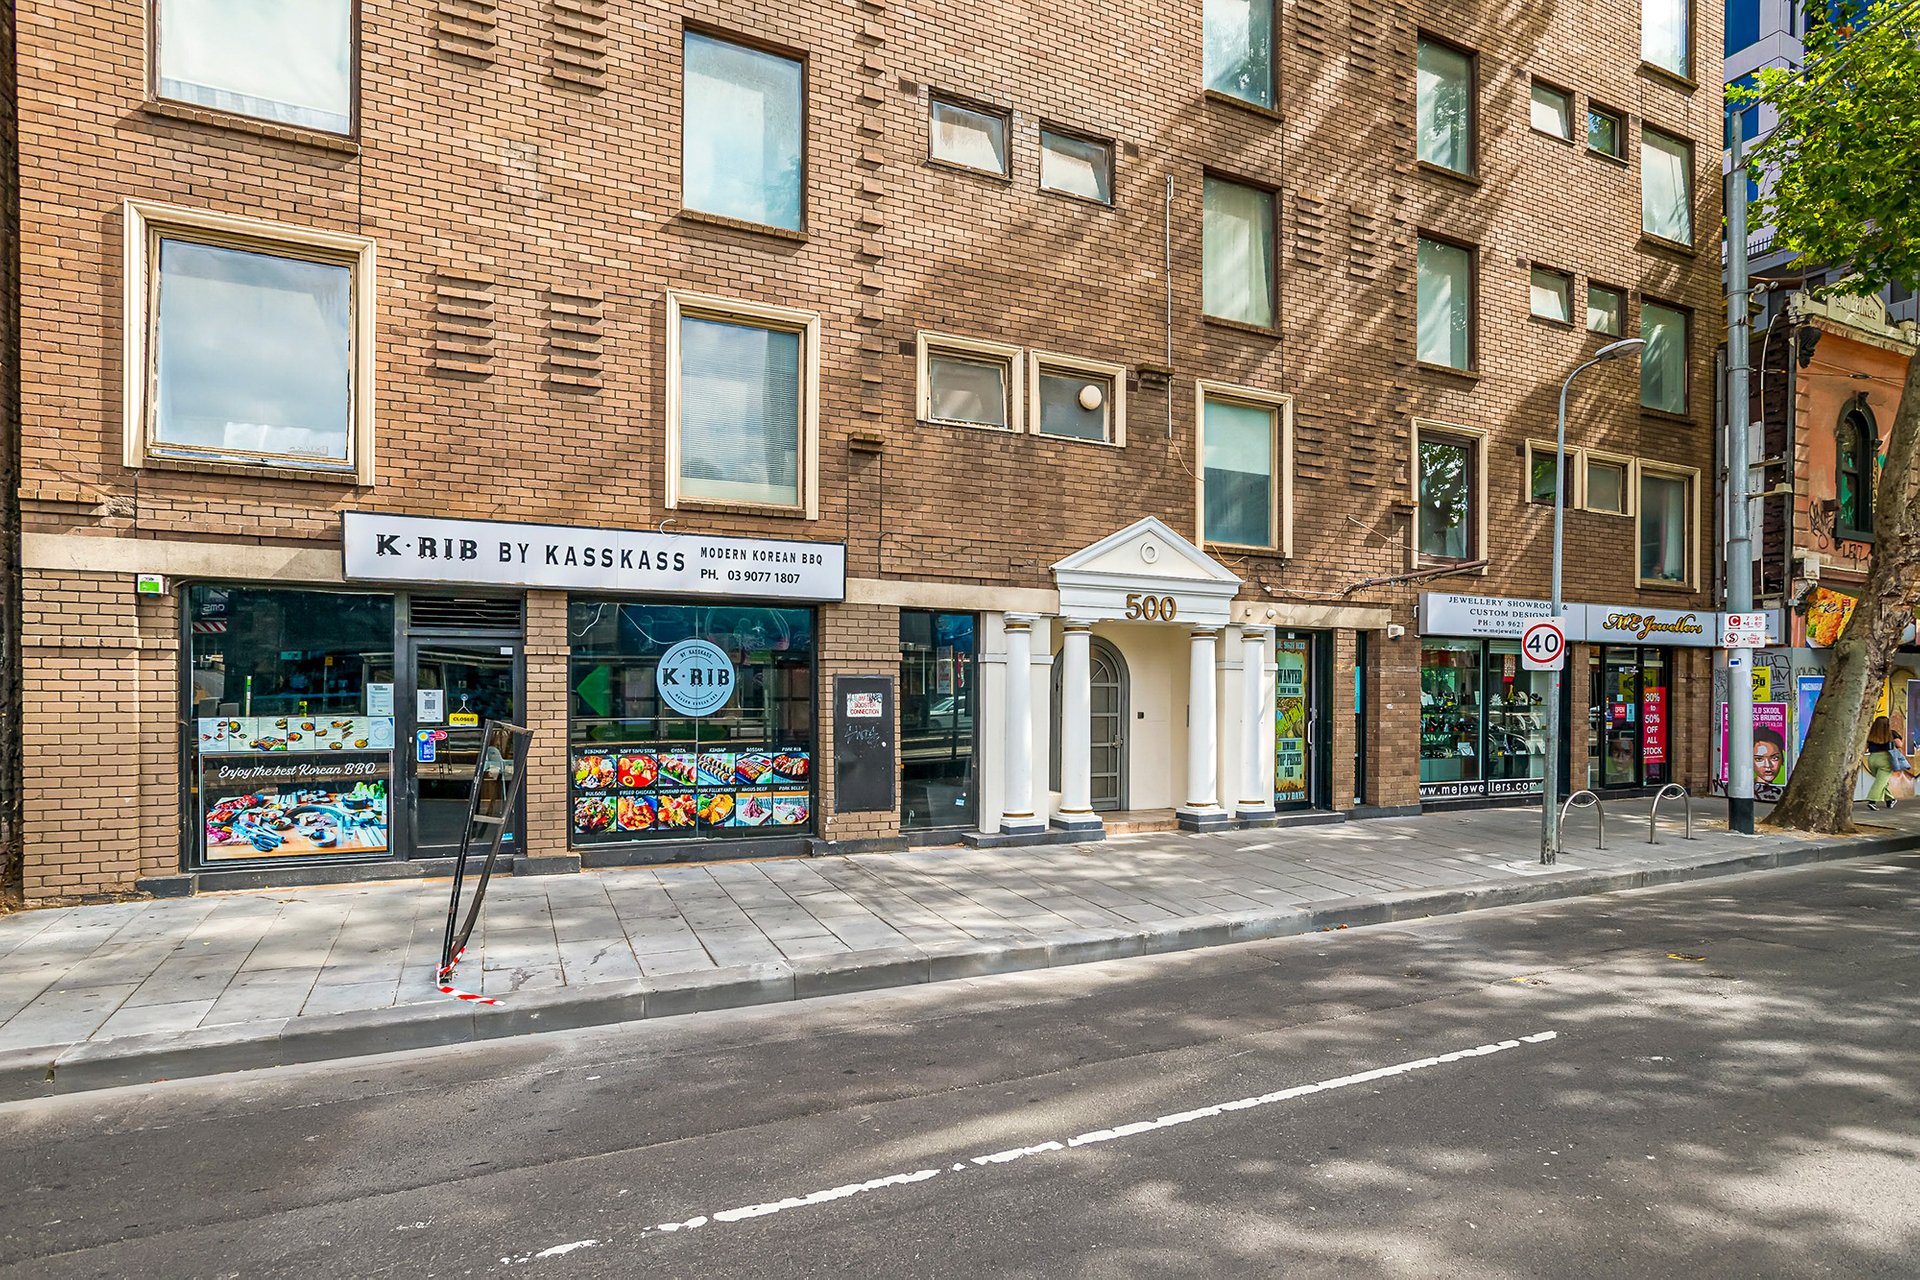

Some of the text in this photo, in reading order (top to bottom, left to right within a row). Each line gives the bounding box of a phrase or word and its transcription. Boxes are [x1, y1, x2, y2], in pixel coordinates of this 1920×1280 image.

[499, 541, 530, 563] BY
[545, 544, 685, 572] KASSKASS
[700, 547, 823, 566] MODERN KOREAN BBQ
[700, 568, 800, 584] PH. 03 9077 1807
[1125, 594, 1177, 621] 500
[1448, 596, 1503, 606] JEWELLERY
[1507, 600, 1552, 610] SHOWROO
[1469, 608, 1509, 617] CUSTOM
[1602, 613, 1703, 640] ME Jewellers
[1527, 633, 1559, 653] 40
[1277, 669, 1303, 684] WANTED
[1645, 692, 1660, 702] 30%
[1644, 714, 1660, 723] 50%
[1646, 726, 1659, 734] OFF
[1646, 736, 1658, 744] ALL
[1643, 747, 1662, 755] STOCK
[218, 765, 251, 780] Enjoy
[272, 765, 297, 776] best
[298, 763, 342, 776] Korean
[343, 762, 377, 775] BBQ
